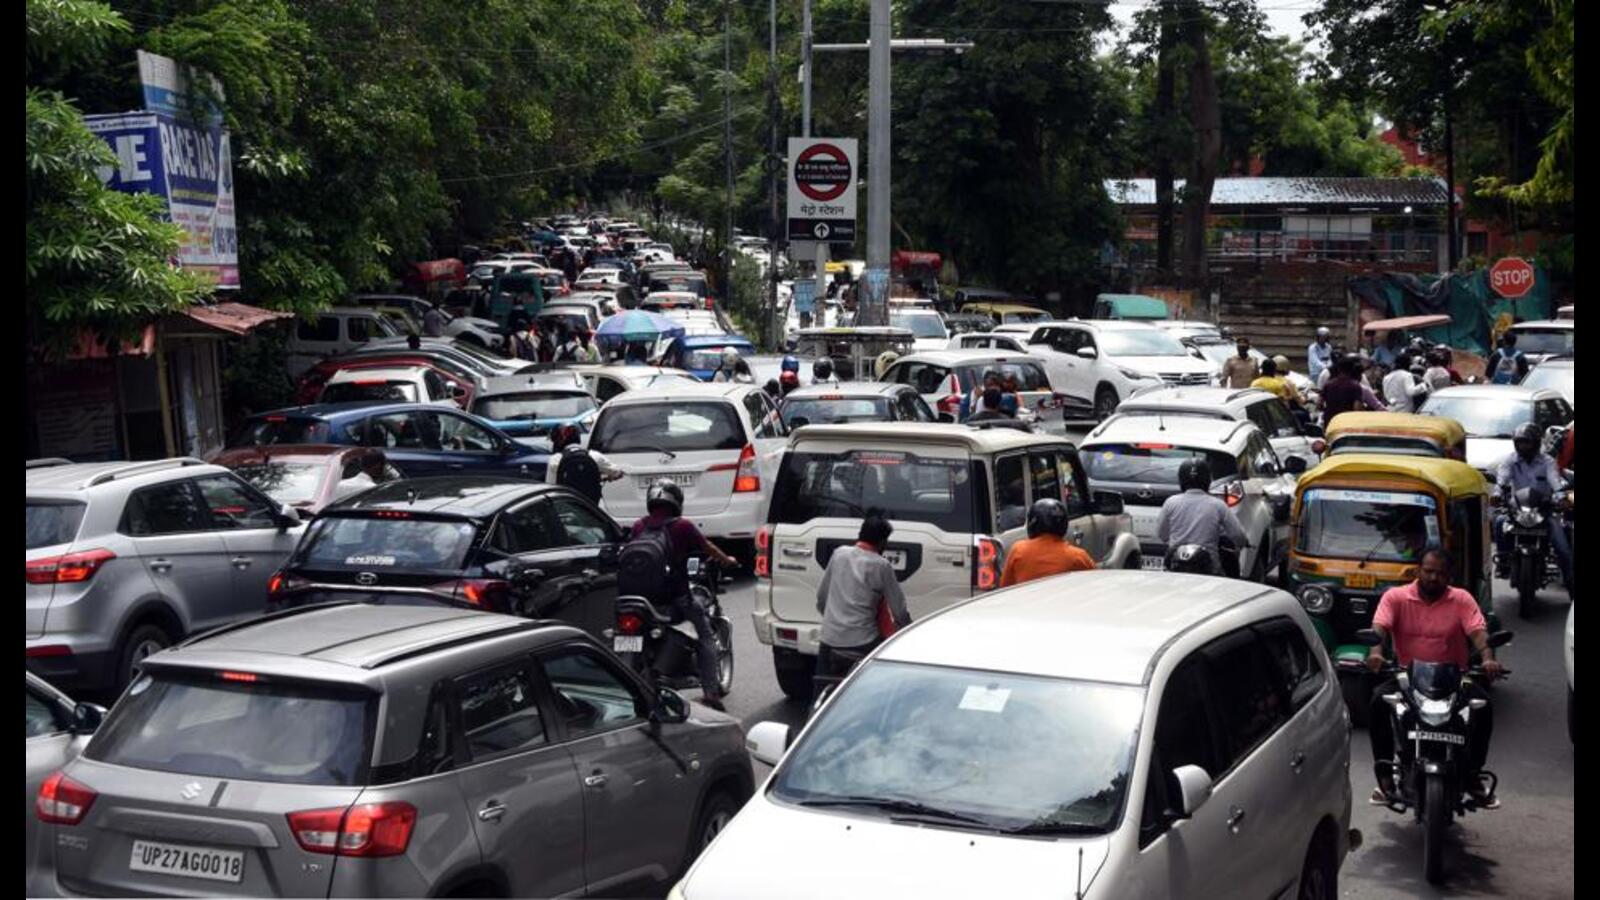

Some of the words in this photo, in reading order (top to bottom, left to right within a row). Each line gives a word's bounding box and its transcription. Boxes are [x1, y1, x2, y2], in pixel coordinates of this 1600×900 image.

[160, 122, 197, 178] RACE
[800, 203, 816, 216] मेट्रो
[819, 203, 844, 216] स्टेशन
[1494, 269, 1530, 286] STOP
[142, 845, 241, 876] UP27AG0018
